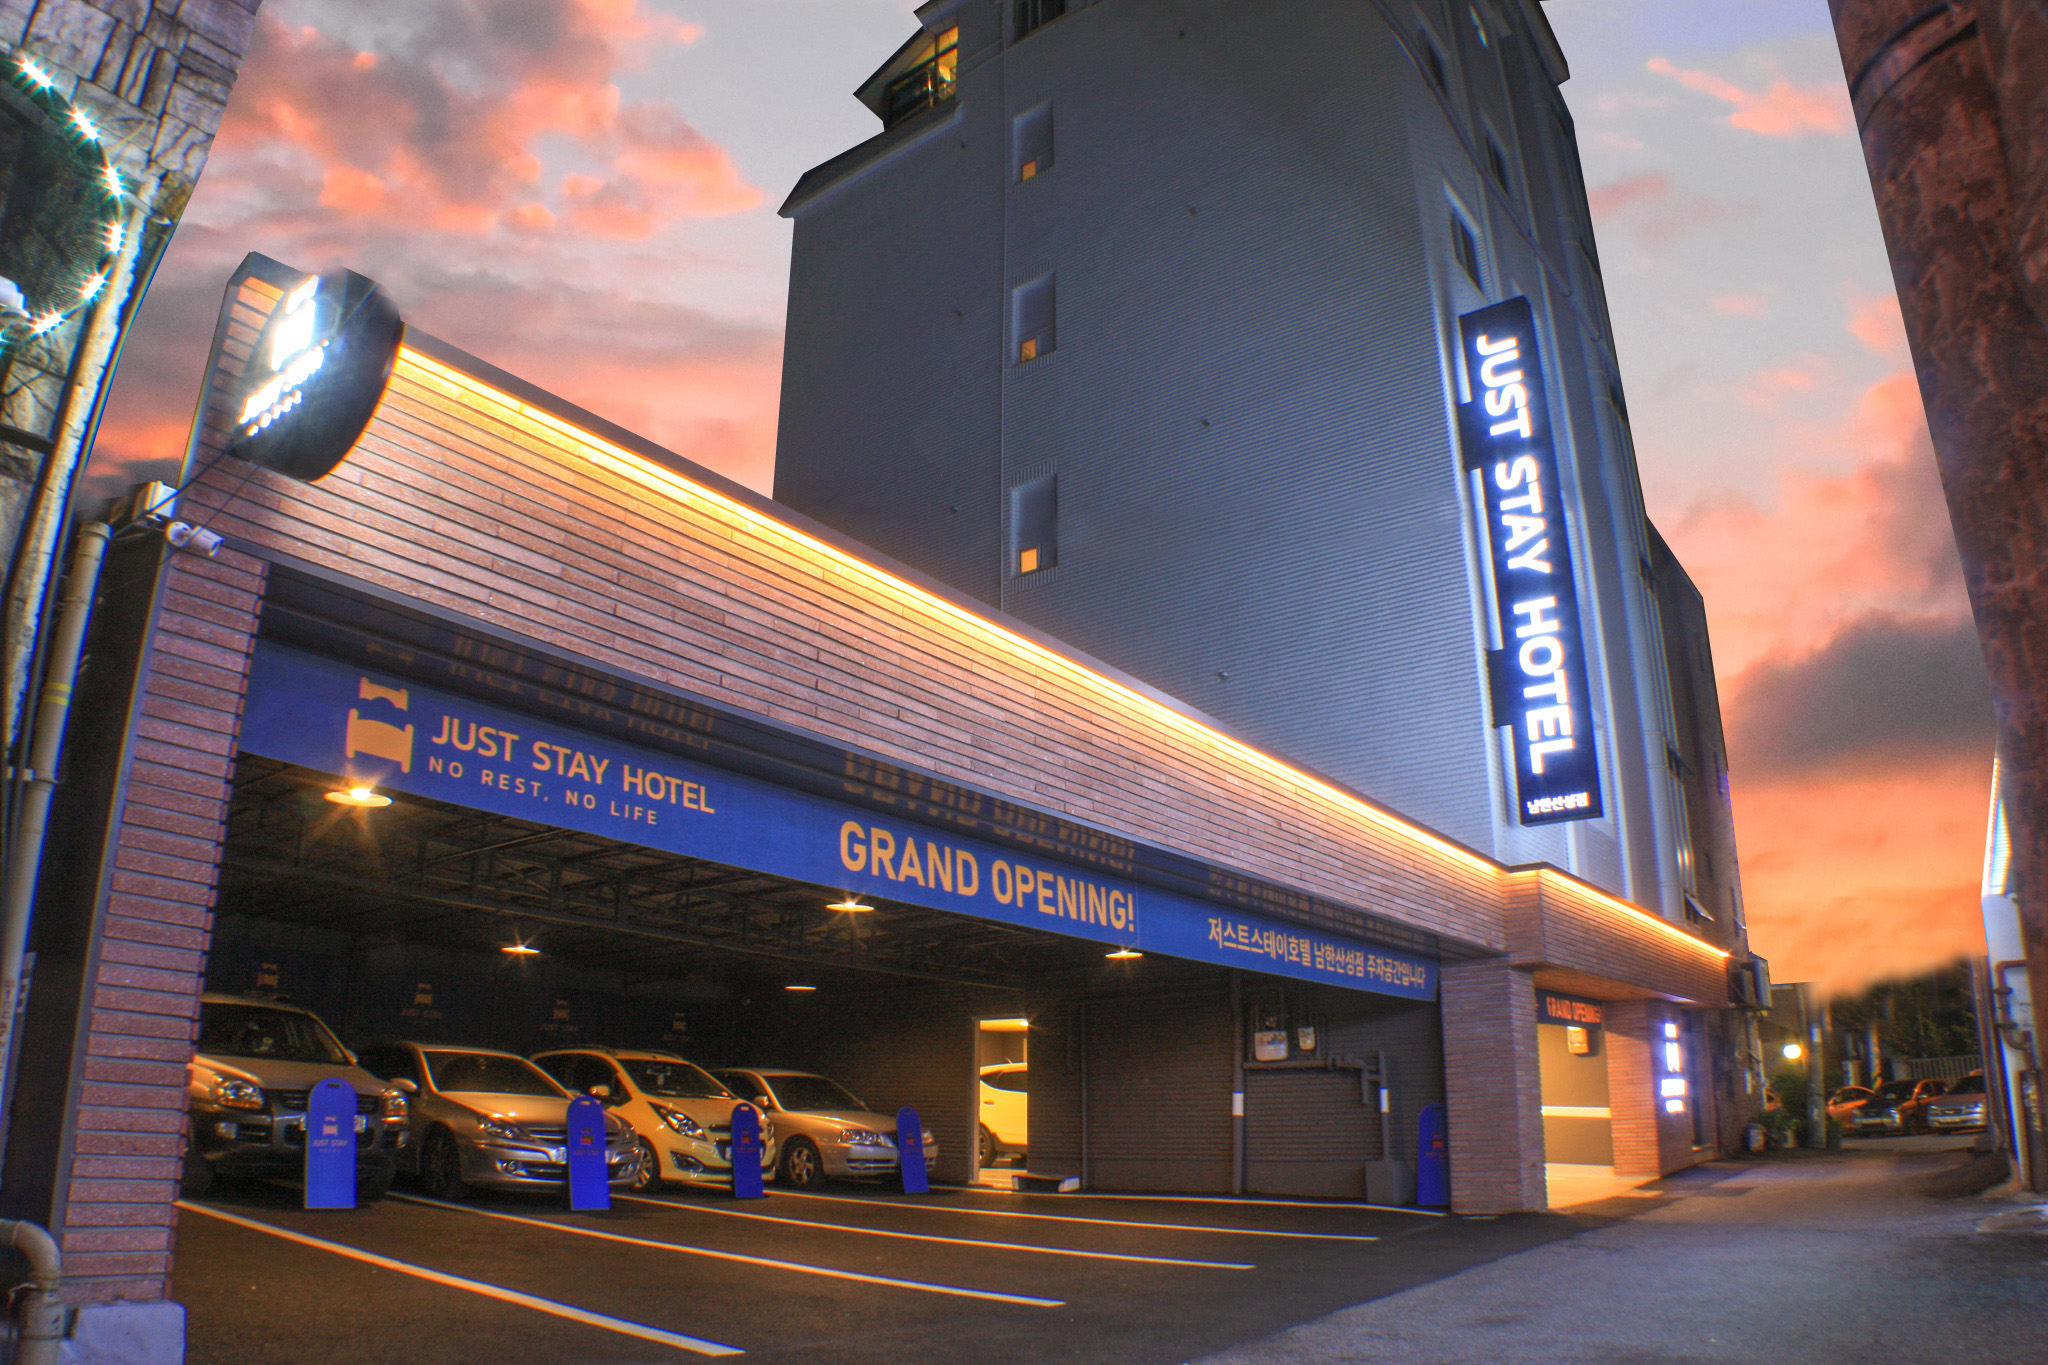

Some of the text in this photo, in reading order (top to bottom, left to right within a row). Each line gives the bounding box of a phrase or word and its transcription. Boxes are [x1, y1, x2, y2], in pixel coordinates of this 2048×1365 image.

[1476, 334, 1575, 774] JUST STAY HOTEL
[429, 756, 657, 825] NO REST, NO LIFE
[432, 715, 715, 814] JUST STAY HOTEL
[840, 820, 979, 897] GRAND
[992, 859, 1135, 932] OPENING!
[1208, 917, 1426, 989] 저스트스테이호텔 남한산성점 주차공간입니다
